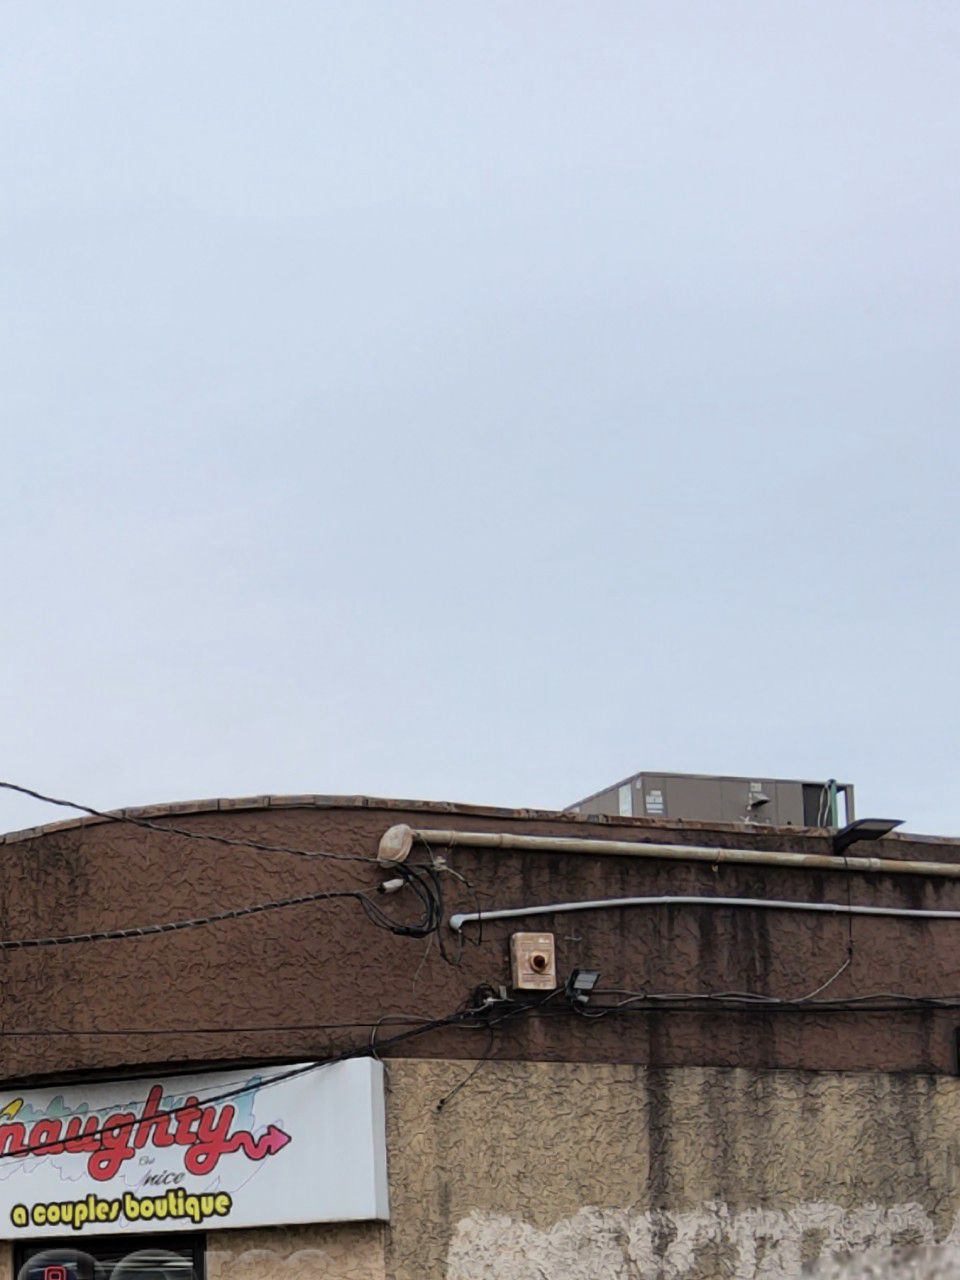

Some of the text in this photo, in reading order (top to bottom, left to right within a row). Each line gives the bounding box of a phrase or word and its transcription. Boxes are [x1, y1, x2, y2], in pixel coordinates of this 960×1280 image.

[143, 1169, 186, 1187] nice
[11, 1187, 232, 1229] a couples boutique
